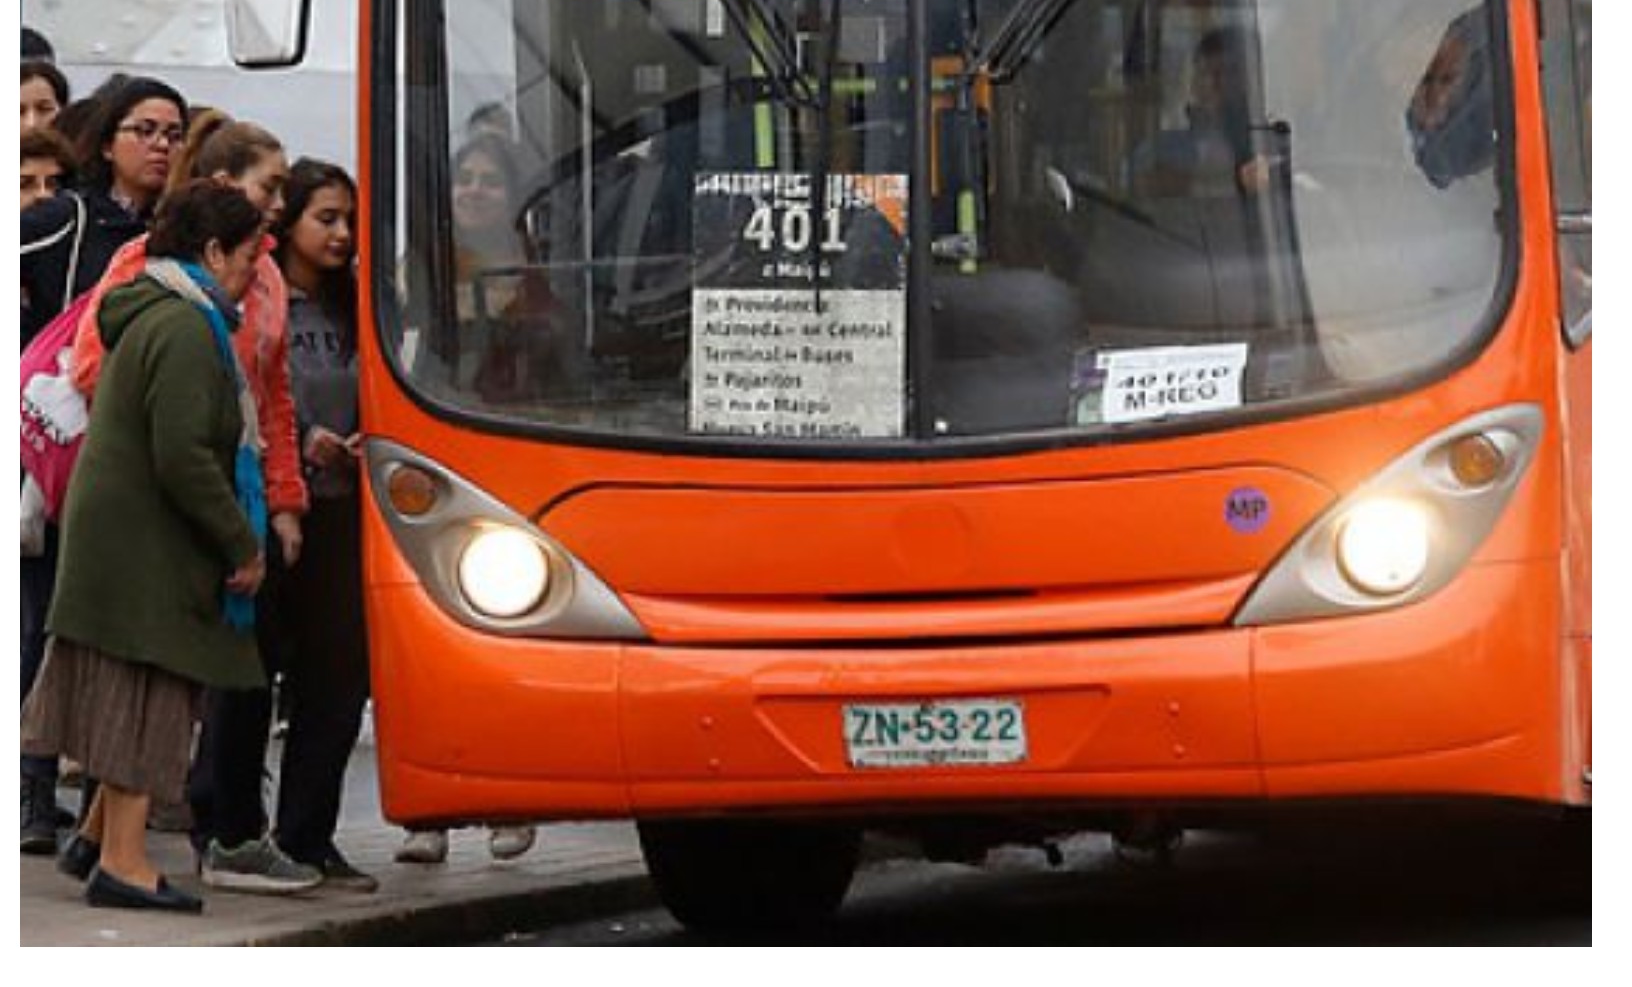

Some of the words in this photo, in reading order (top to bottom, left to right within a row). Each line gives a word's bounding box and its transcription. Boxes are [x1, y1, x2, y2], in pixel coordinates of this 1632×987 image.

[743, 207, 848, 252] 401
[725, 297, 829, 313] Providenca
[827, 321, 893, 338] Central
